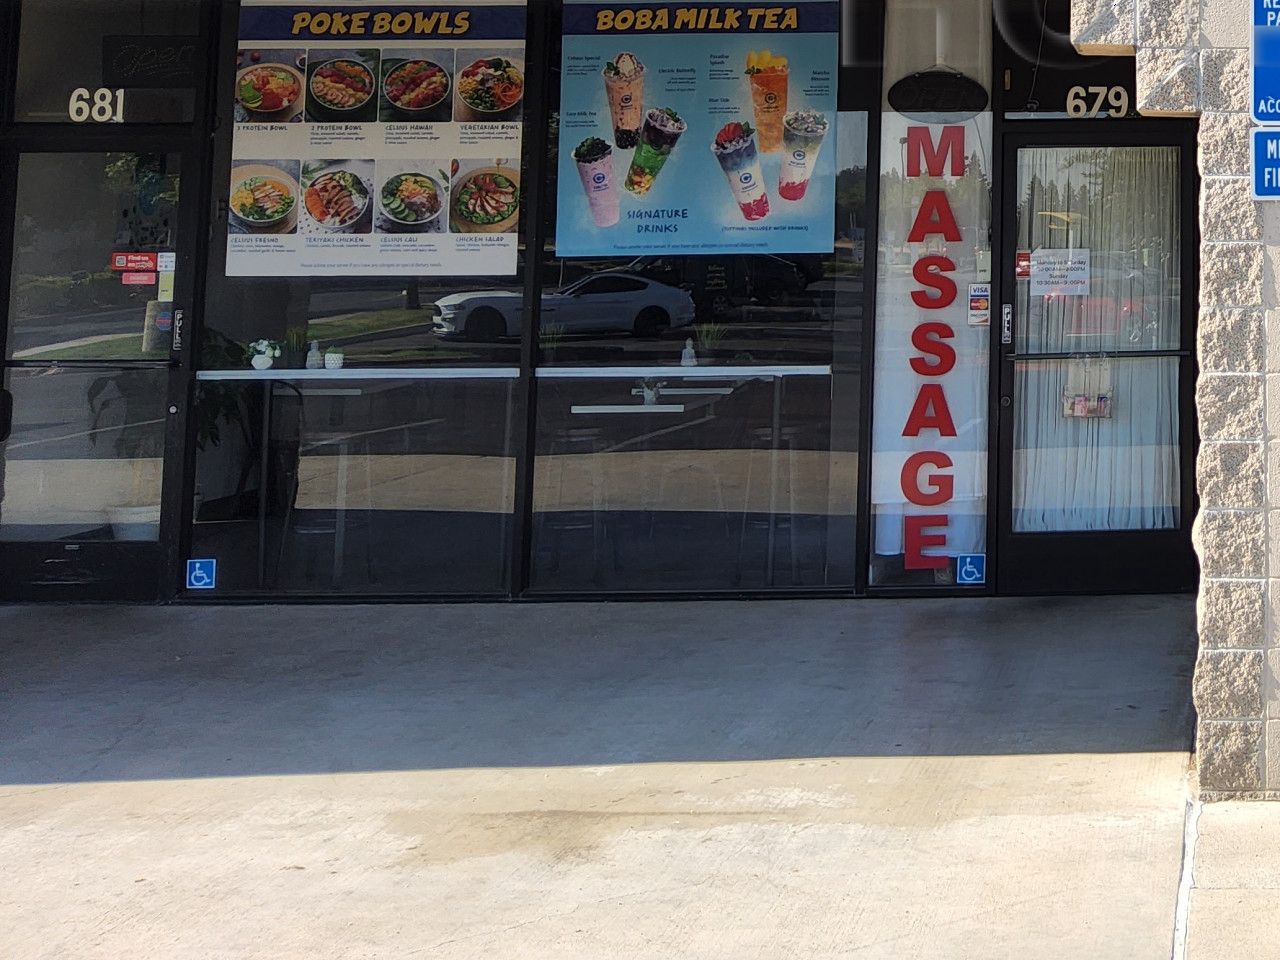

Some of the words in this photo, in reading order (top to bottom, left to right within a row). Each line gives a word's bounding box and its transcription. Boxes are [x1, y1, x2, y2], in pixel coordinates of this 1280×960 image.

[291, 11, 370, 35] POKE
[372, 11, 470, 34] BOWLS
[596, 8, 669, 31] BOBA
[673, 8, 742, 30] MILK
[747, 7, 798, 29] TEA
[69, 87, 125, 124] 681
[1066, 85, 1129, 118] 679
[627, 209, 689, 219] SIGNATURE
[636, 224, 679, 234] DRINKS
[900, 125, 966, 571] MASSAGE
